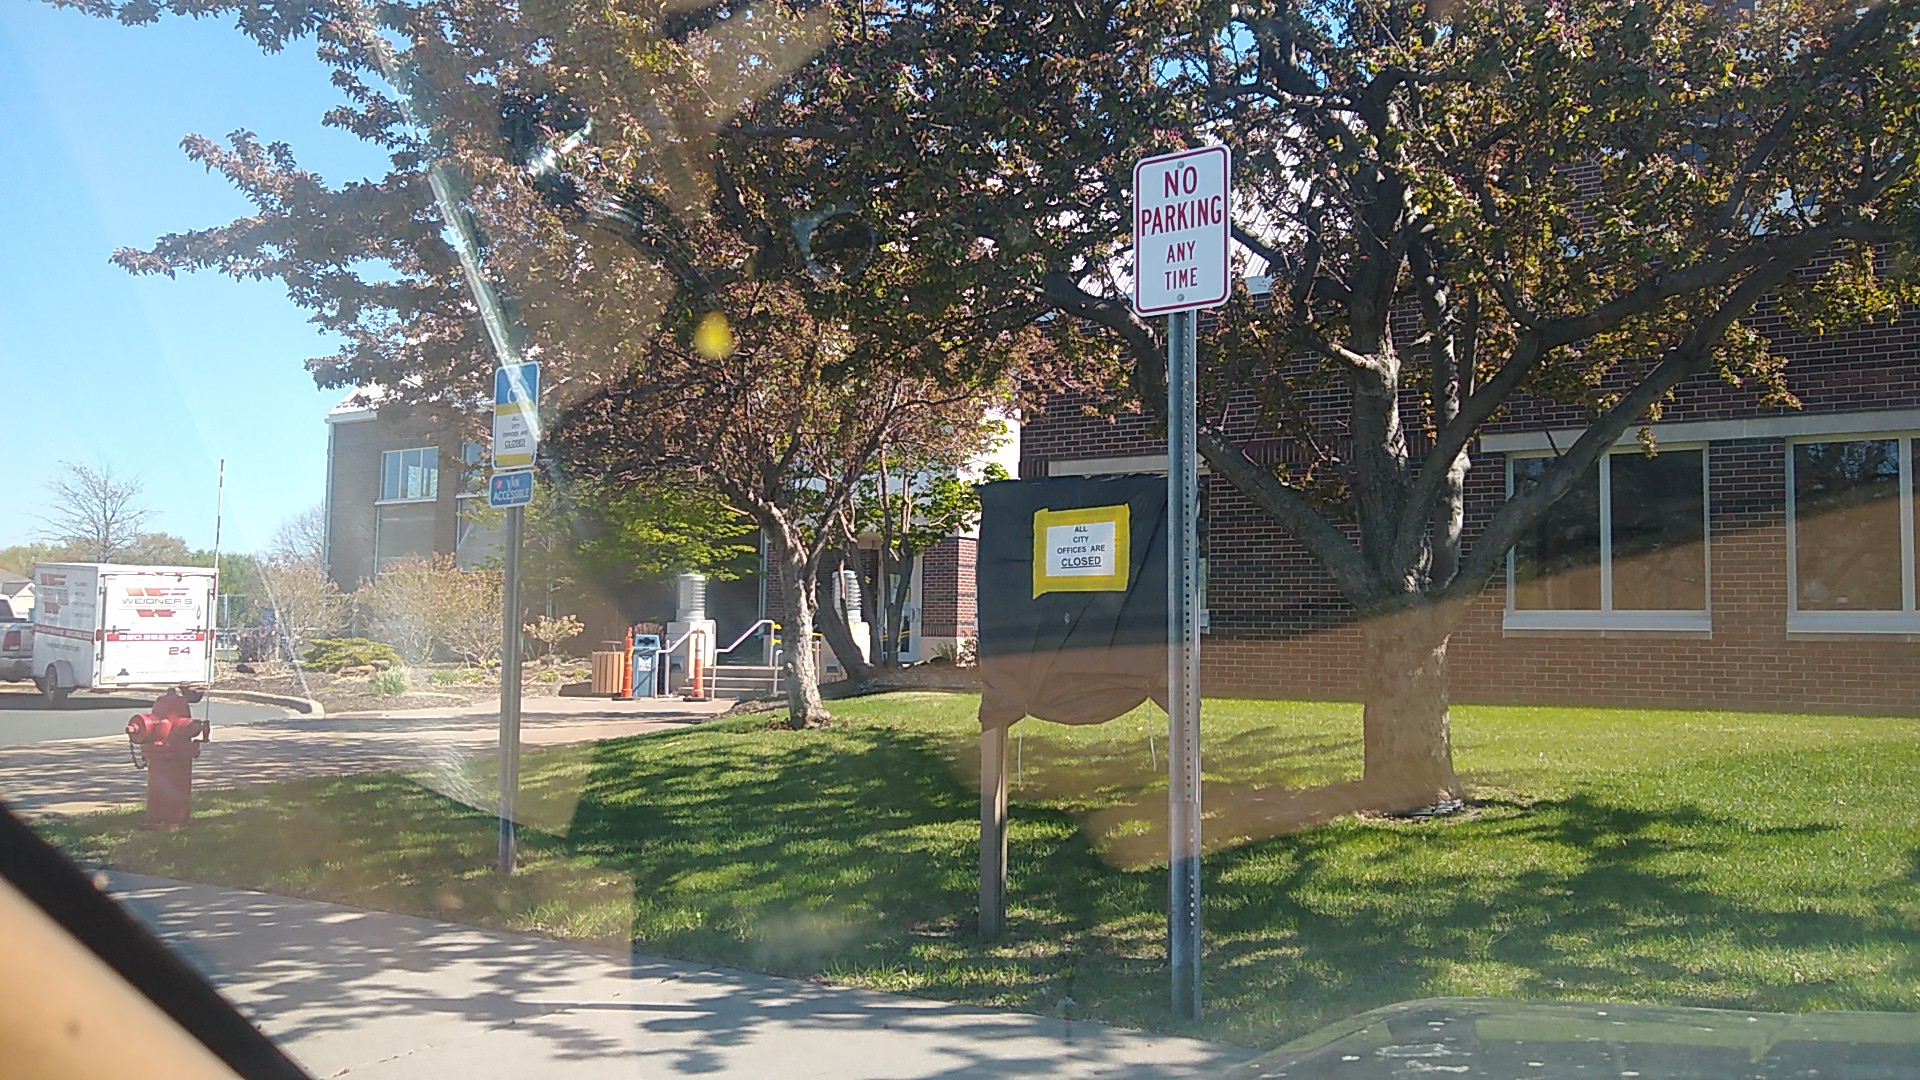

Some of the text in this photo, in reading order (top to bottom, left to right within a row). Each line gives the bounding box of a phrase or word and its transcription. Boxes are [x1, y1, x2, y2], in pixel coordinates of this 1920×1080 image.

[1164, 166, 1197, 198] NO
[1141, 195, 1222, 237] PARKING
[1166, 240, 1196, 264] ANY
[1164, 267, 1198, 290] TIME
[504, 438, 526, 448] CLOSED
[506, 478, 520, 488] VAN
[493, 488, 529, 500] ACCESSIBLE
[1057, 544, 1106, 554] OFFICES ARE
[1061, 556, 1102, 568] CLOSED
[168, 646, 191, 656] 24
